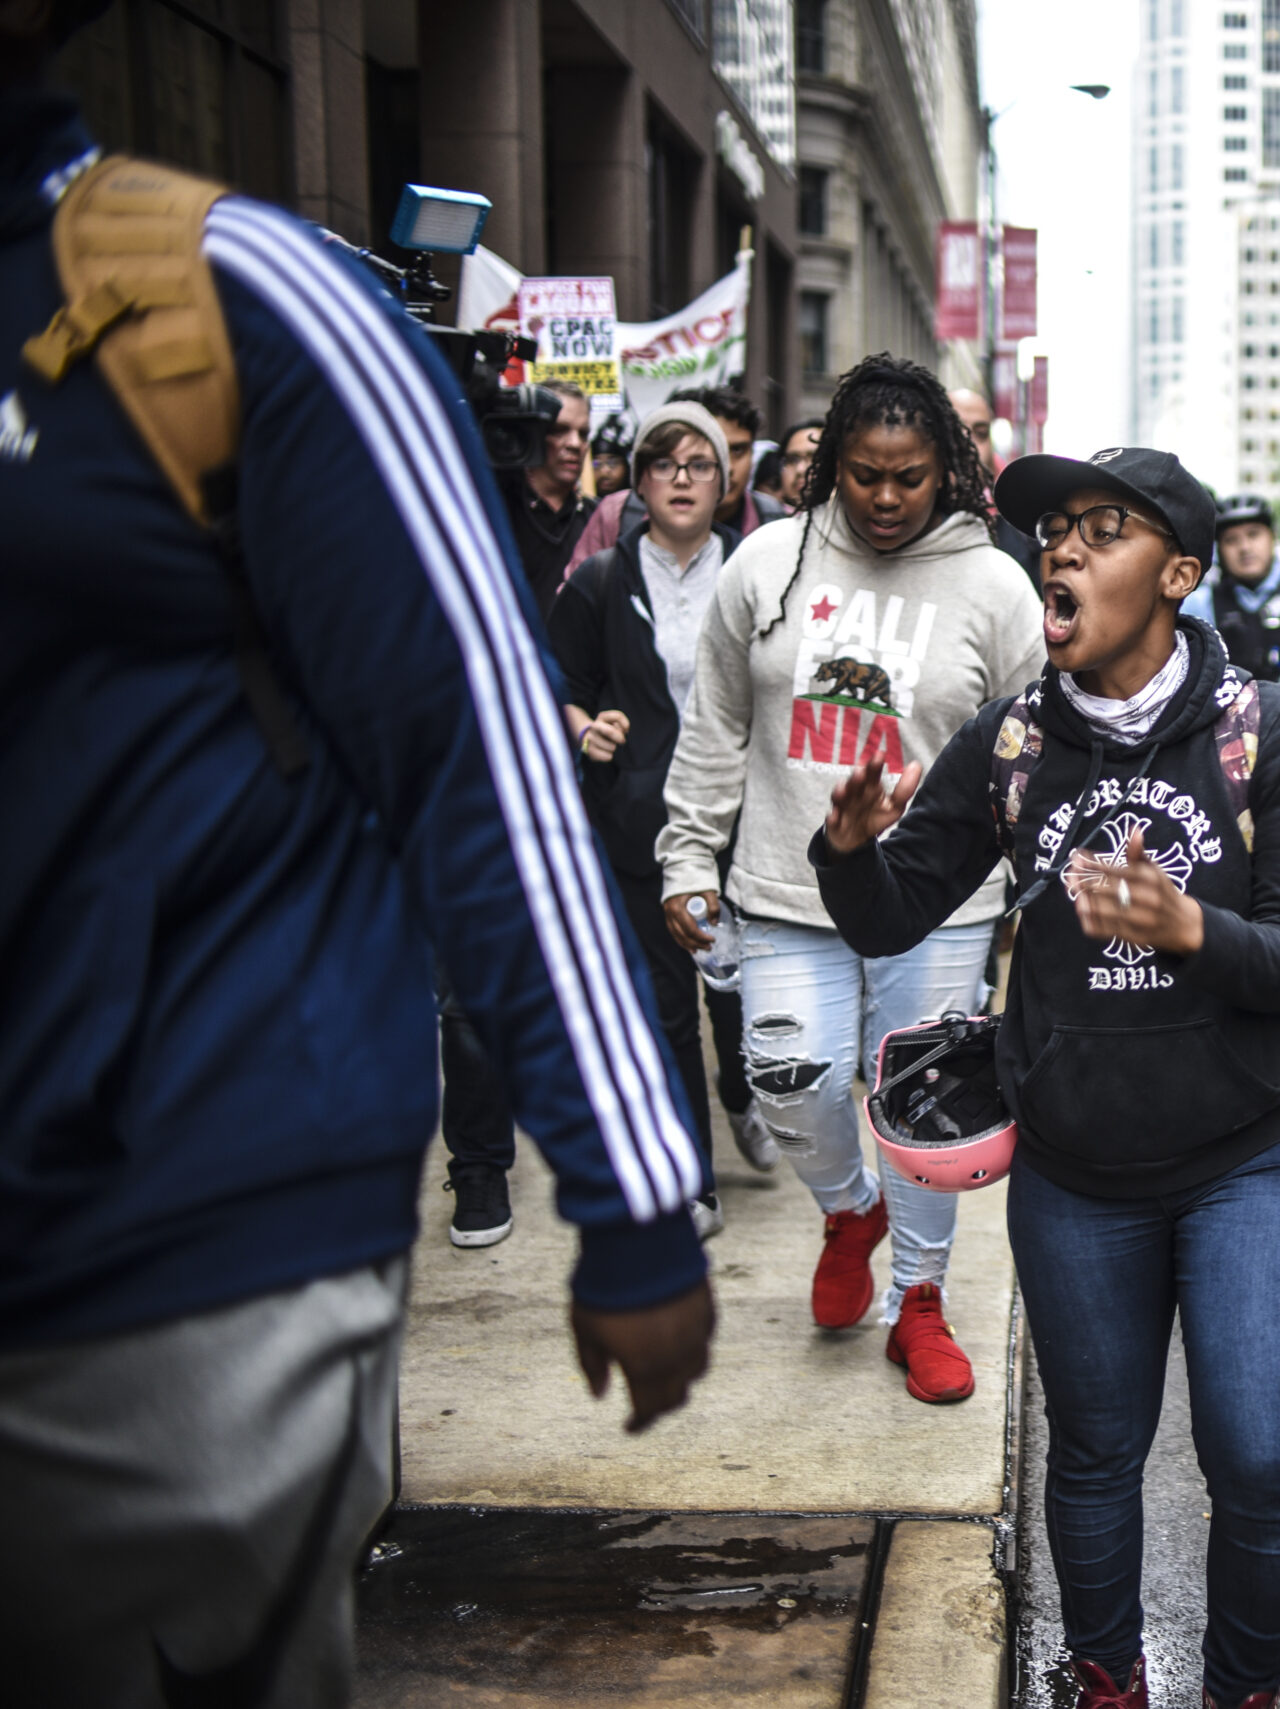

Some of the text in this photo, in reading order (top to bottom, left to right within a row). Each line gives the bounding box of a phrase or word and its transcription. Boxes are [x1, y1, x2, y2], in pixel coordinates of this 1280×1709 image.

[549, 317, 613, 336] CPAC
[552, 337, 612, 357] NOW
[803, 584, 937, 661] CALI
[788, 698, 904, 774] NIA
